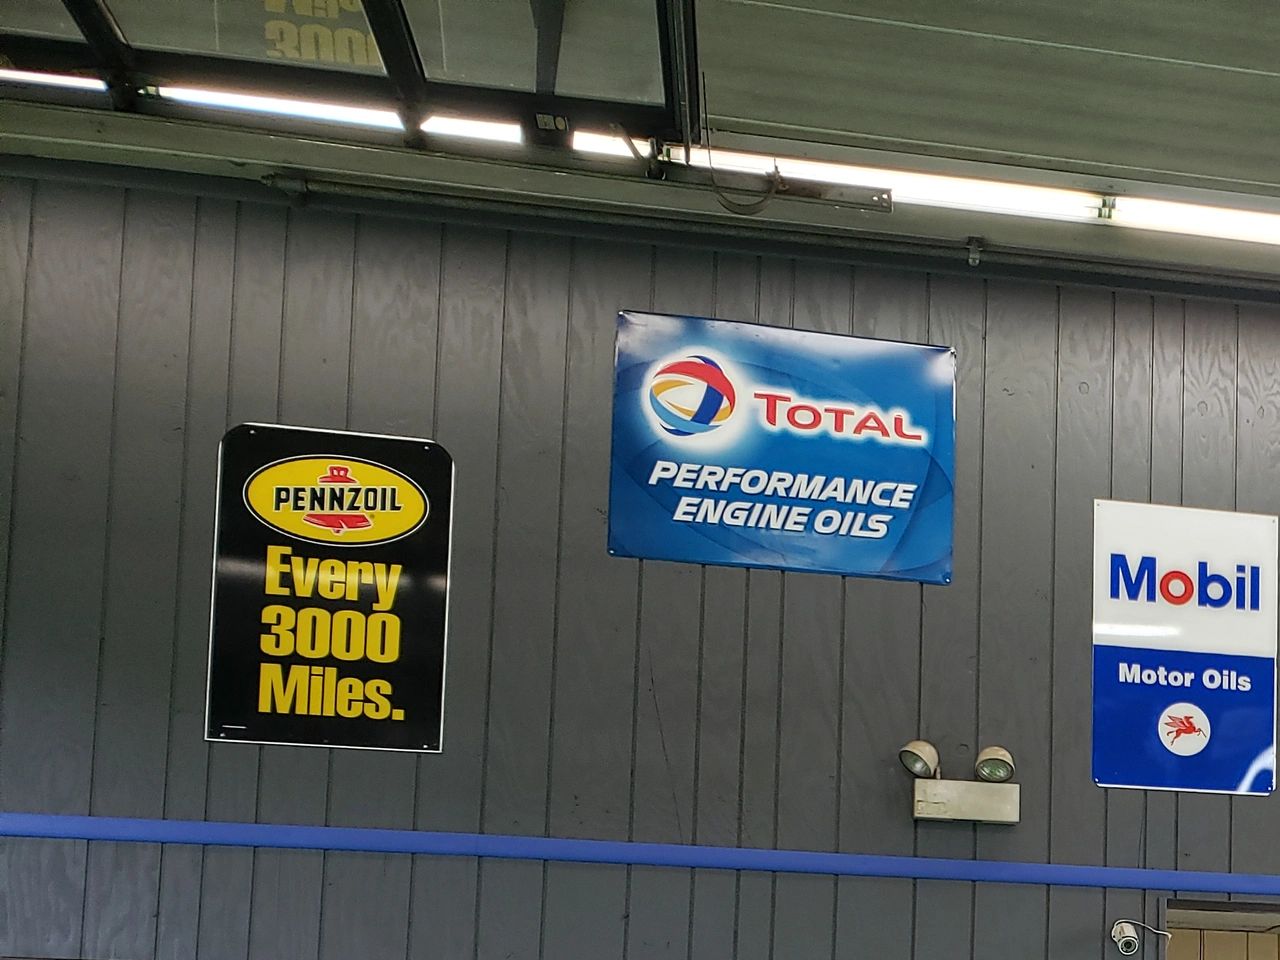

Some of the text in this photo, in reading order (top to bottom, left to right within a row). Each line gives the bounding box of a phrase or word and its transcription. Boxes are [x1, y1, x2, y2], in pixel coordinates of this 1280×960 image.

[753, 391, 923, 441] TOTAL
[273, 486, 403, 513] PENNZOIL
[648, 459, 919, 510] PERFORMANCE
[672, 495, 895, 539] ENGINE OILS
[264, 544, 403, 611] Every
[1109, 552, 1261, 612] Mobil
[259, 604, 401, 664] 3000
[257, 662, 406, 721] Miles.
[1118, 662, 1252, 692] Motor Oils
